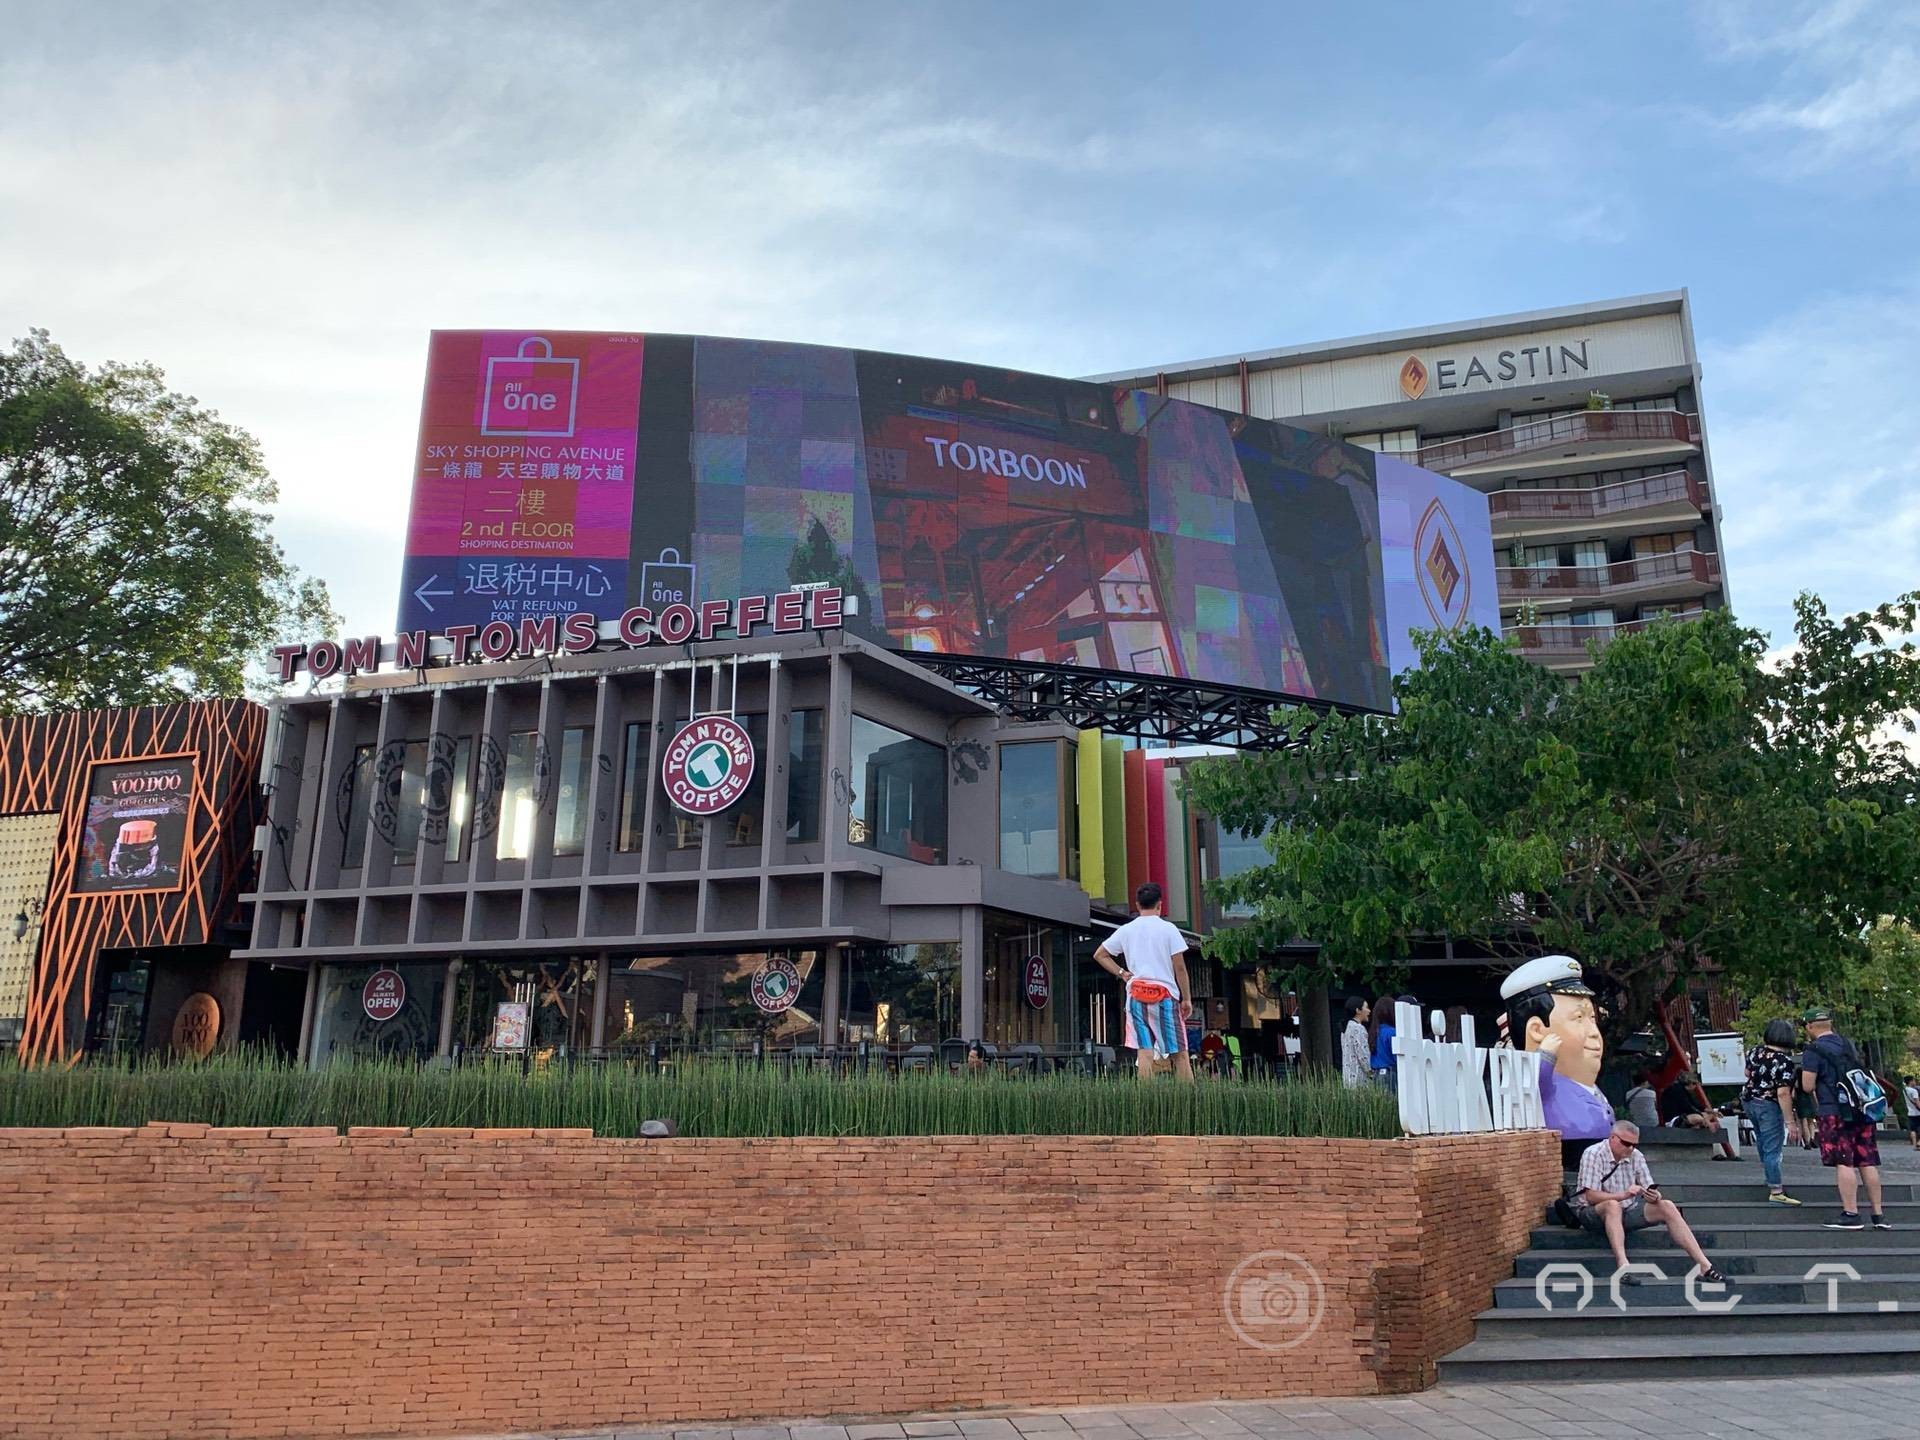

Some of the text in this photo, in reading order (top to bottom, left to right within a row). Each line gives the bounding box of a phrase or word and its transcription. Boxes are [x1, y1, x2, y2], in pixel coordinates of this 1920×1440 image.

[1437, 341, 1589, 390] EASTIN
[503, 393, 557, 411] one
[426, 445, 625, 461] SKY SHOPPING AVENUE
[925, 436, 1087, 488] TORBOON
[497, 462, 625, 481] 天空購物大道
[484, 488, 547, 516] 二樓
[461, 522, 575, 537] 2 nd FLOOR
[460, 539, 574, 550] SHOPPING DESTINATION
[463, 562, 612, 597] 退税中心
[652, 589, 683, 602] one
[492, 600, 577, 611] VAT REFUND
[491, 612, 514, 621] FOR
[274, 585, 844, 682] TOM N TOMS COFFEE
[669, 733, 696, 774] TOM
[714, 723, 748, 766] TOMS
[673, 774, 743, 807] COFFEE
[1032, 963, 1044, 978] 24
[375, 977, 396, 991] 24
[1028, 984, 1048, 997] OPEN
[367, 997, 399, 1009] OPEN
[756, 991, 795, 1009] COFFEE
